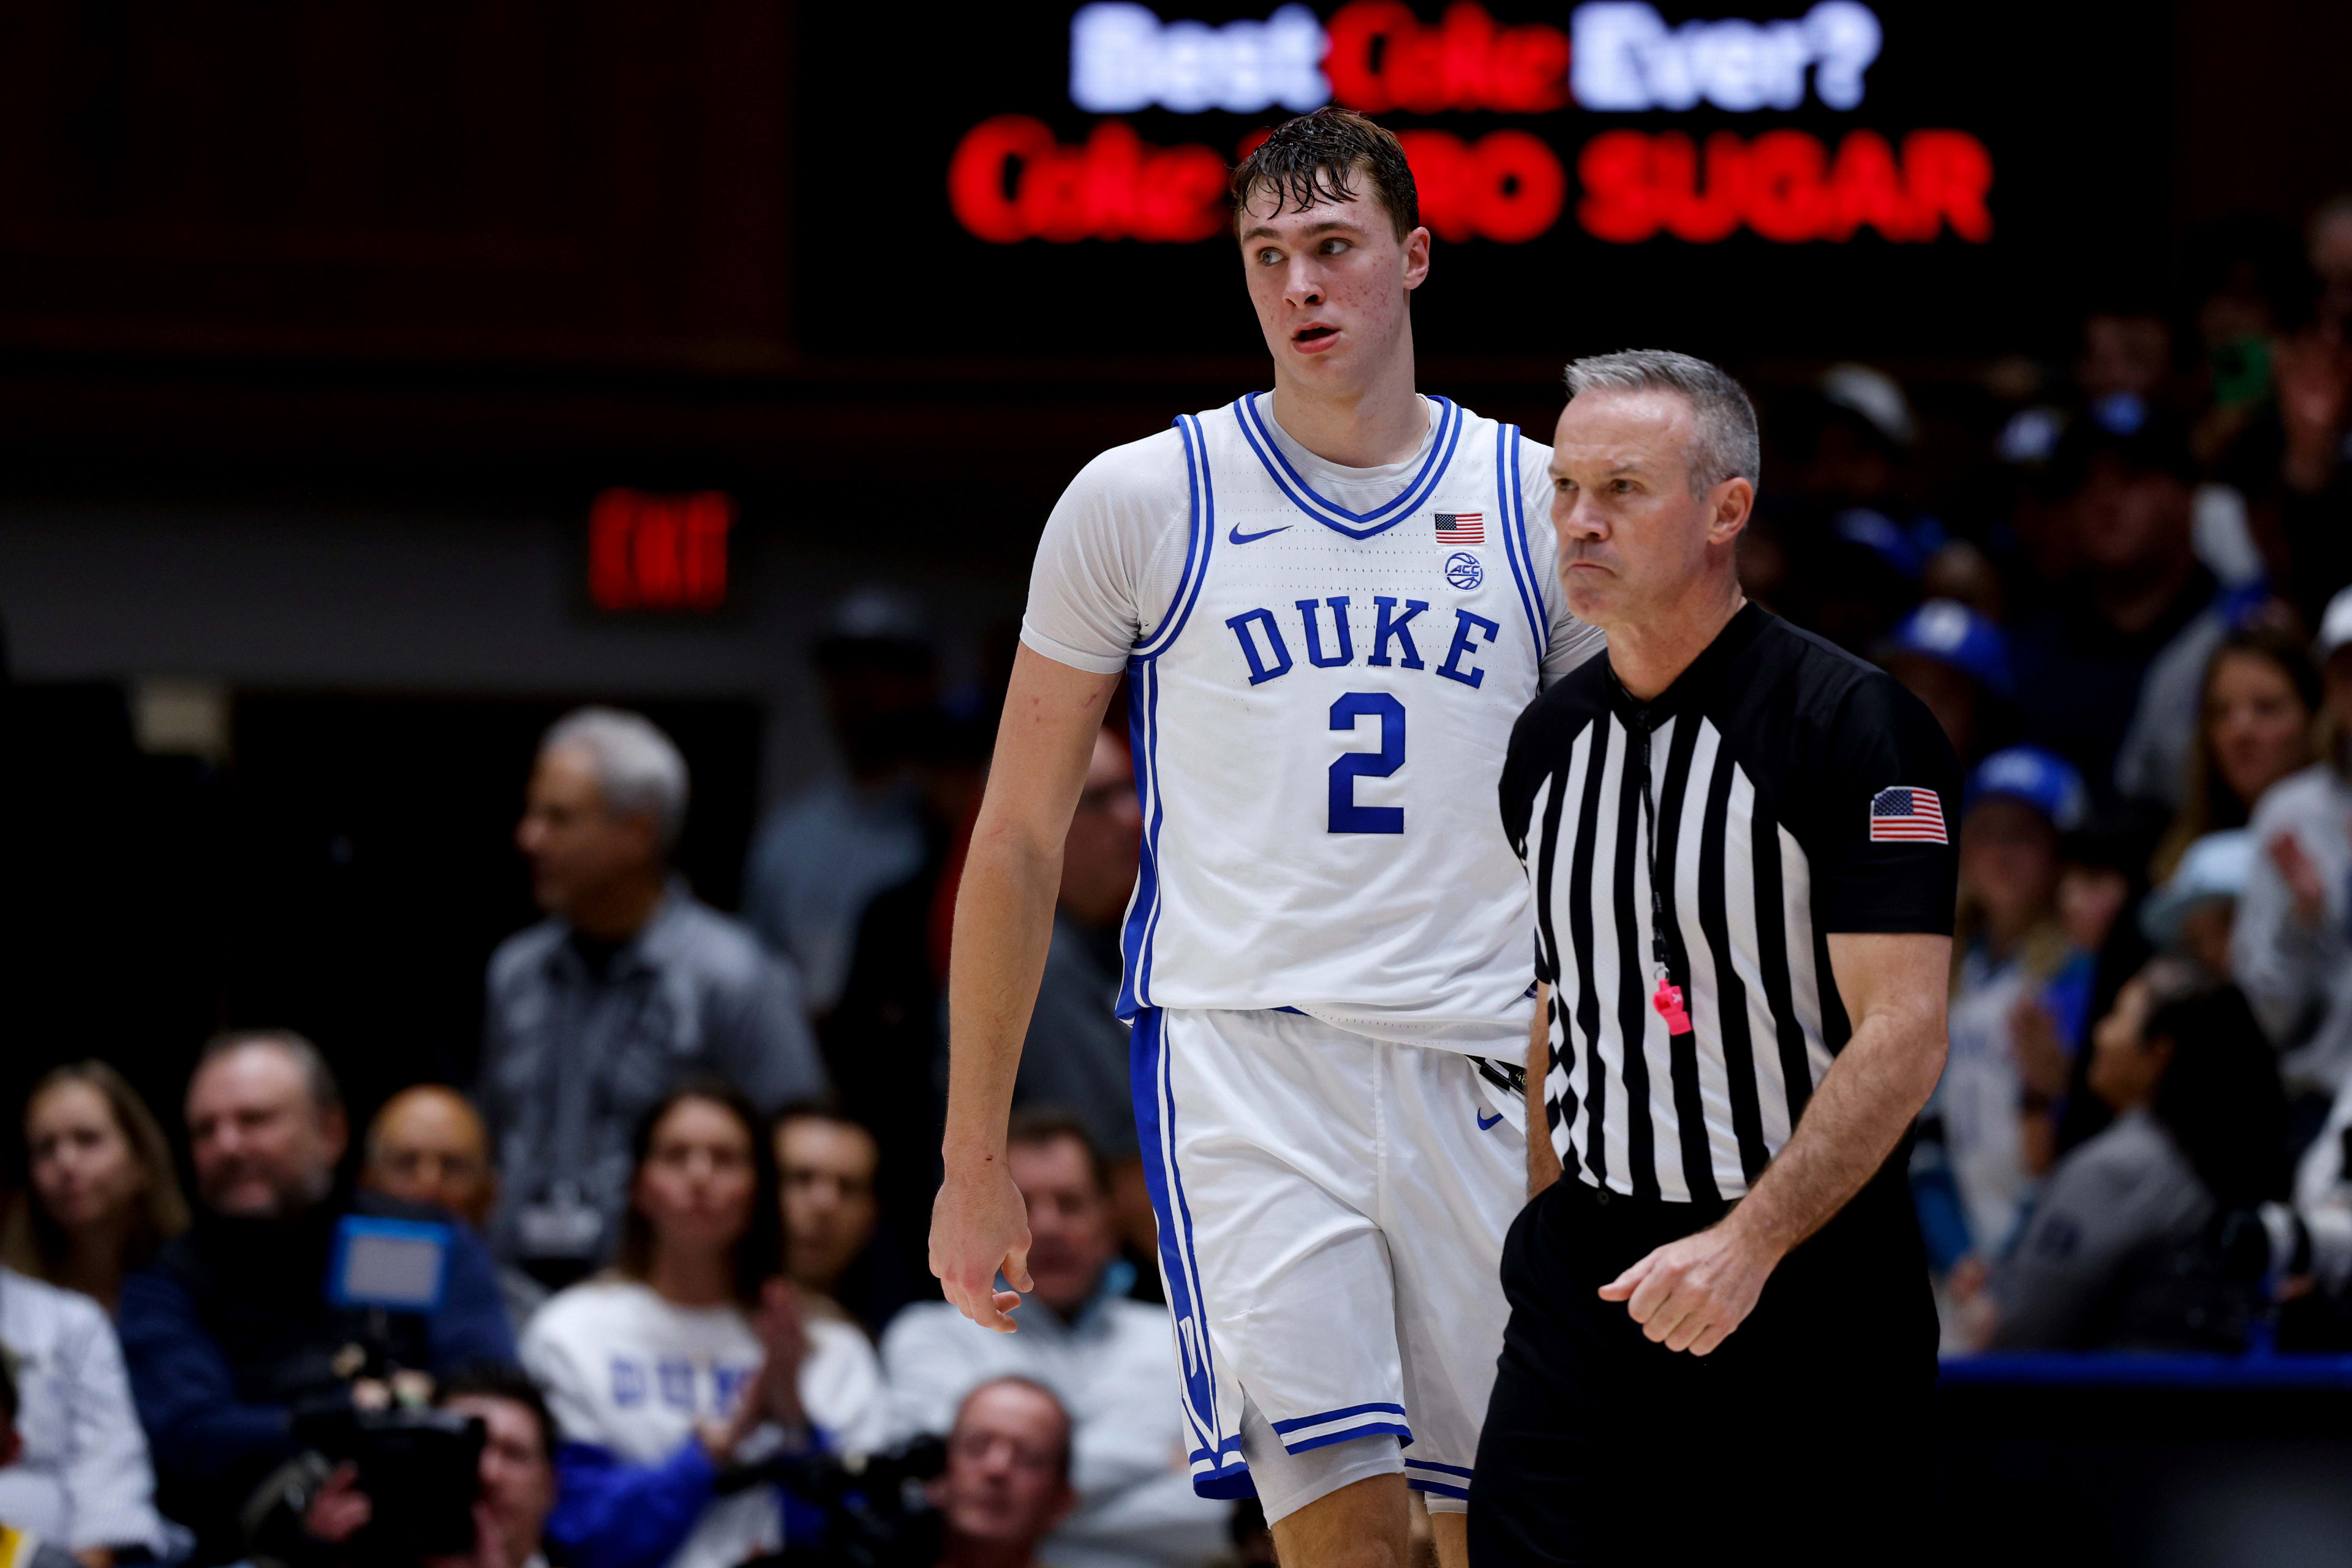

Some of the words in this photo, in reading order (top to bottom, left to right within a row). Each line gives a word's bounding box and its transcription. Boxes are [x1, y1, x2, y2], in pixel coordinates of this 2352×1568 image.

[1071, 2, 1325, 115] Best
[1571, 1, 1881, 111] Ever?
[1578, 129, 1992, 243] SUGAR
[1450, 564, 1481, 574] ACC
[1225, 595, 1500, 689] DUKE
[1327, 692, 1406, 834] 2
